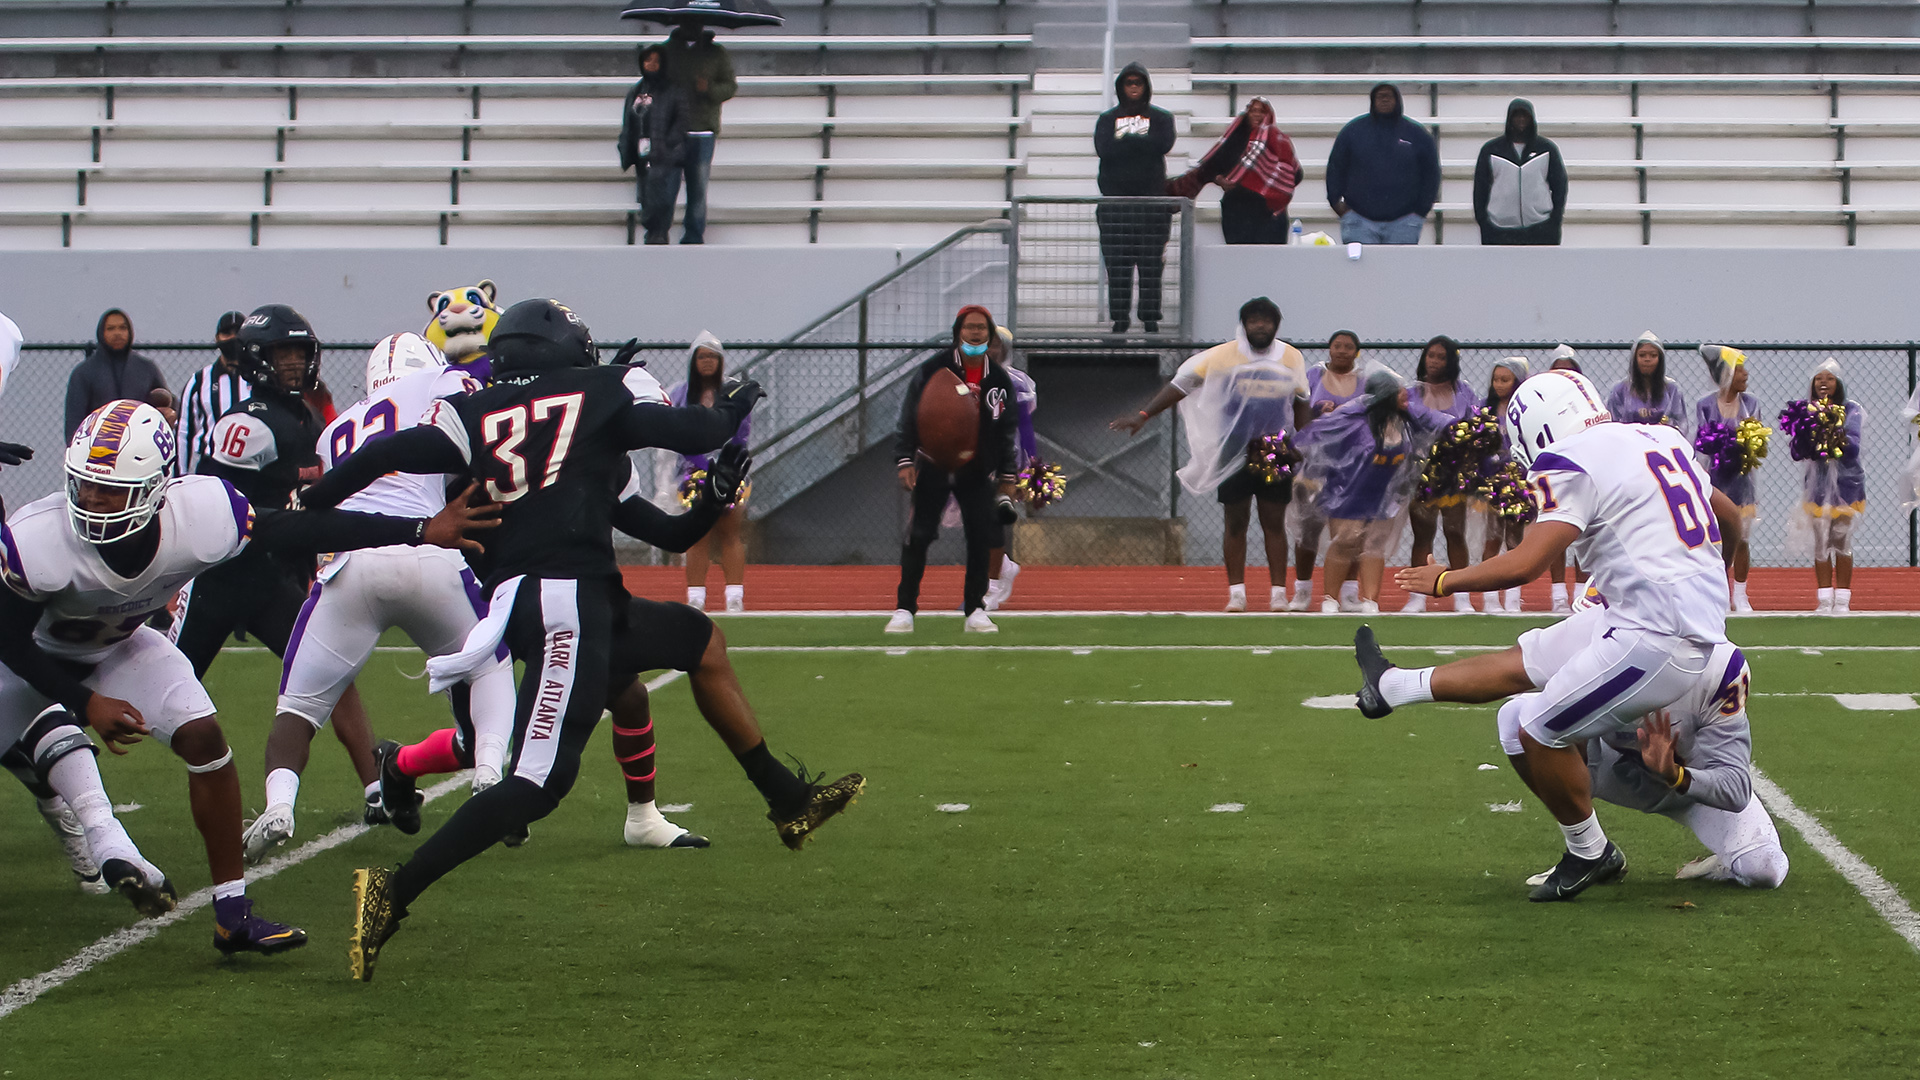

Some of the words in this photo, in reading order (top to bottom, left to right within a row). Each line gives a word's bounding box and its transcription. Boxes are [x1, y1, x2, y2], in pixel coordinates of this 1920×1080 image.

[221, 422, 251, 458] 16
[481, 391, 585, 504] 37
[1644, 446, 1722, 550] 61
[530, 679, 565, 740] ATLANTA
